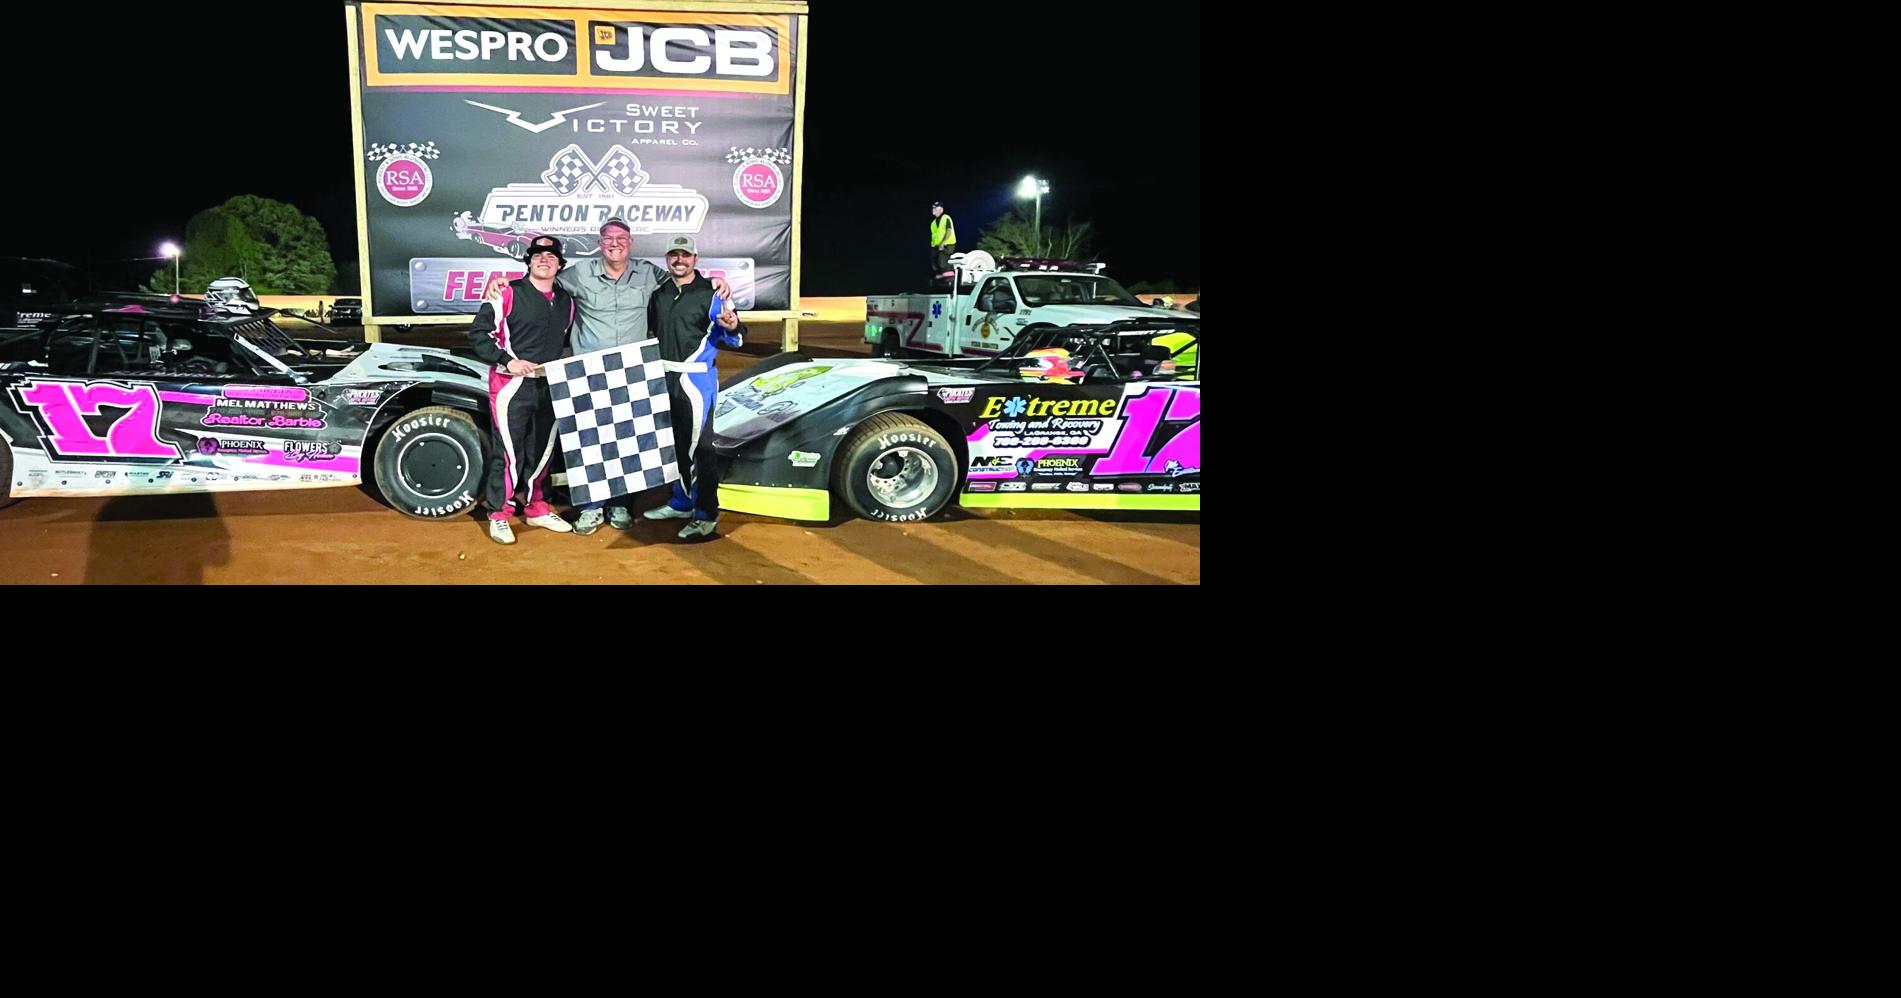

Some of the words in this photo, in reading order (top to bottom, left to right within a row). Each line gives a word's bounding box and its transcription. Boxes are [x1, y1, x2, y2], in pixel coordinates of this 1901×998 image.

[384, 29, 569, 62] WESPRO
[595, 27, 775, 76] JCB
[626, 104, 699, 118] SWEET
[385, 170, 424, 185] RSA
[742, 173, 776, 188] RSA
[496, 204, 589, 222] PENTON
[594, 204, 696, 222] RACEWAY
[216, 399, 244, 408] MEL
[245, 401, 316, 411] MATTHEWS
[18, 382, 182, 456] 17
[204, 413, 265, 426] Realtor
[268, 415, 321, 427] Barbie
[989, 418, 1026, 434] Towing
[1027, 416, 1051, 429] and
[1051, 417, 1101, 434] Recovery
[392, 414, 450, 442] Hoosier
[221, 440, 264, 449] PHOENIX
[284, 441, 328, 453] FLOWERS
[878, 433, 937, 450] Hoosier
[1037, 459, 1078, 467] PHOENIX
[415, 490, 474, 517] Hoosier
